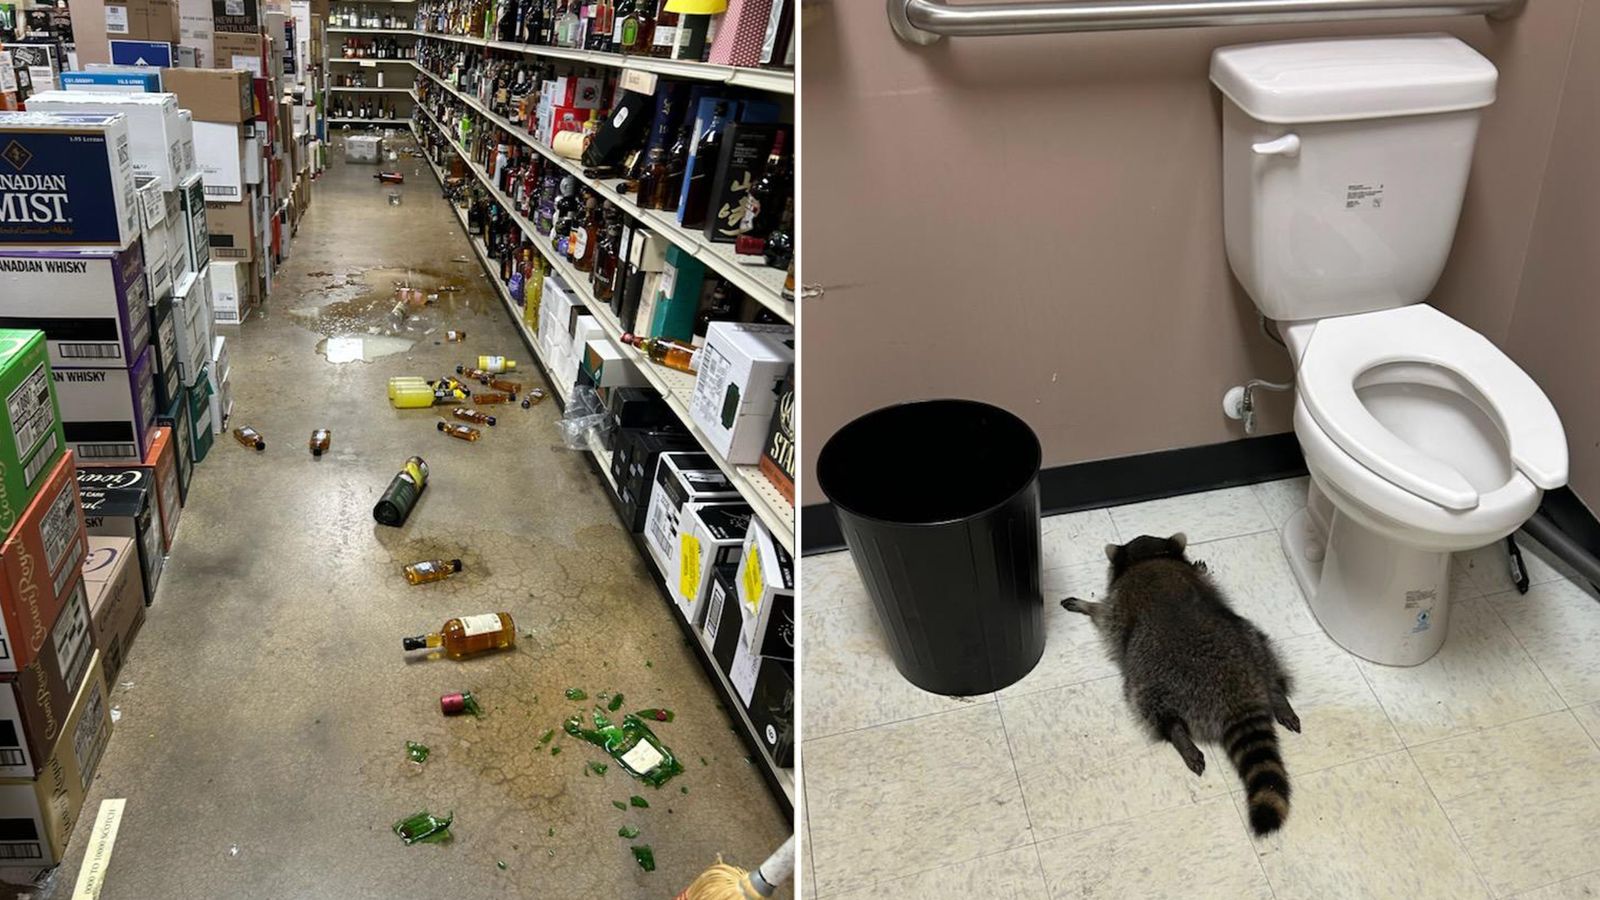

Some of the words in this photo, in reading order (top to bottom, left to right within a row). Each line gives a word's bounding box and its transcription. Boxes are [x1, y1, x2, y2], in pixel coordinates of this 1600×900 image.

[45, 261, 87, 273] WHISKY
[66, 371, 106, 382] WHISKY
[770, 431, 795, 479] STA
[85, 516, 104, 528] SKY
[101, 809, 117, 839] SCOTCH
